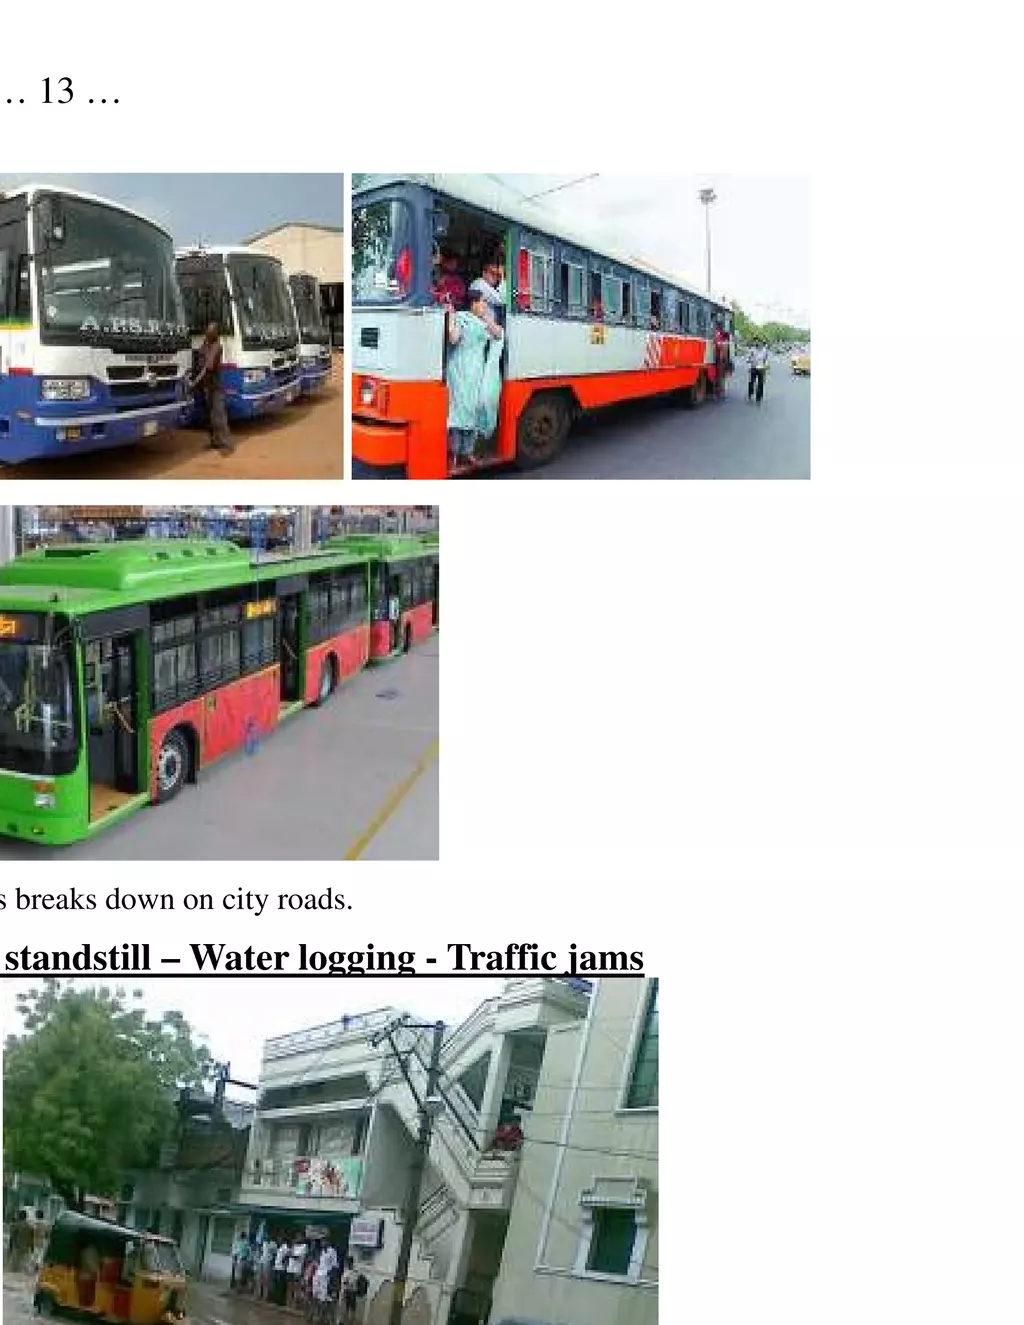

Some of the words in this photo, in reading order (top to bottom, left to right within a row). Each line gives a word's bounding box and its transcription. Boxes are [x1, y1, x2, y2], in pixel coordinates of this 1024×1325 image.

[42, 76, 74, 104] 13
[15, 887, 97, 910] breaks
[105, 887, 175, 910] down
[183, 893, 214, 910] on
[222, 886, 269, 917] city
[277, 887, 352, 910] roads.
[5, 943, 152, 971] standstill
[188, 943, 290, 971] Water
[298, 942, 416, 975] logging
[447, 942, 557, 971] Traffic
[563, 942, 644, 975] jams
